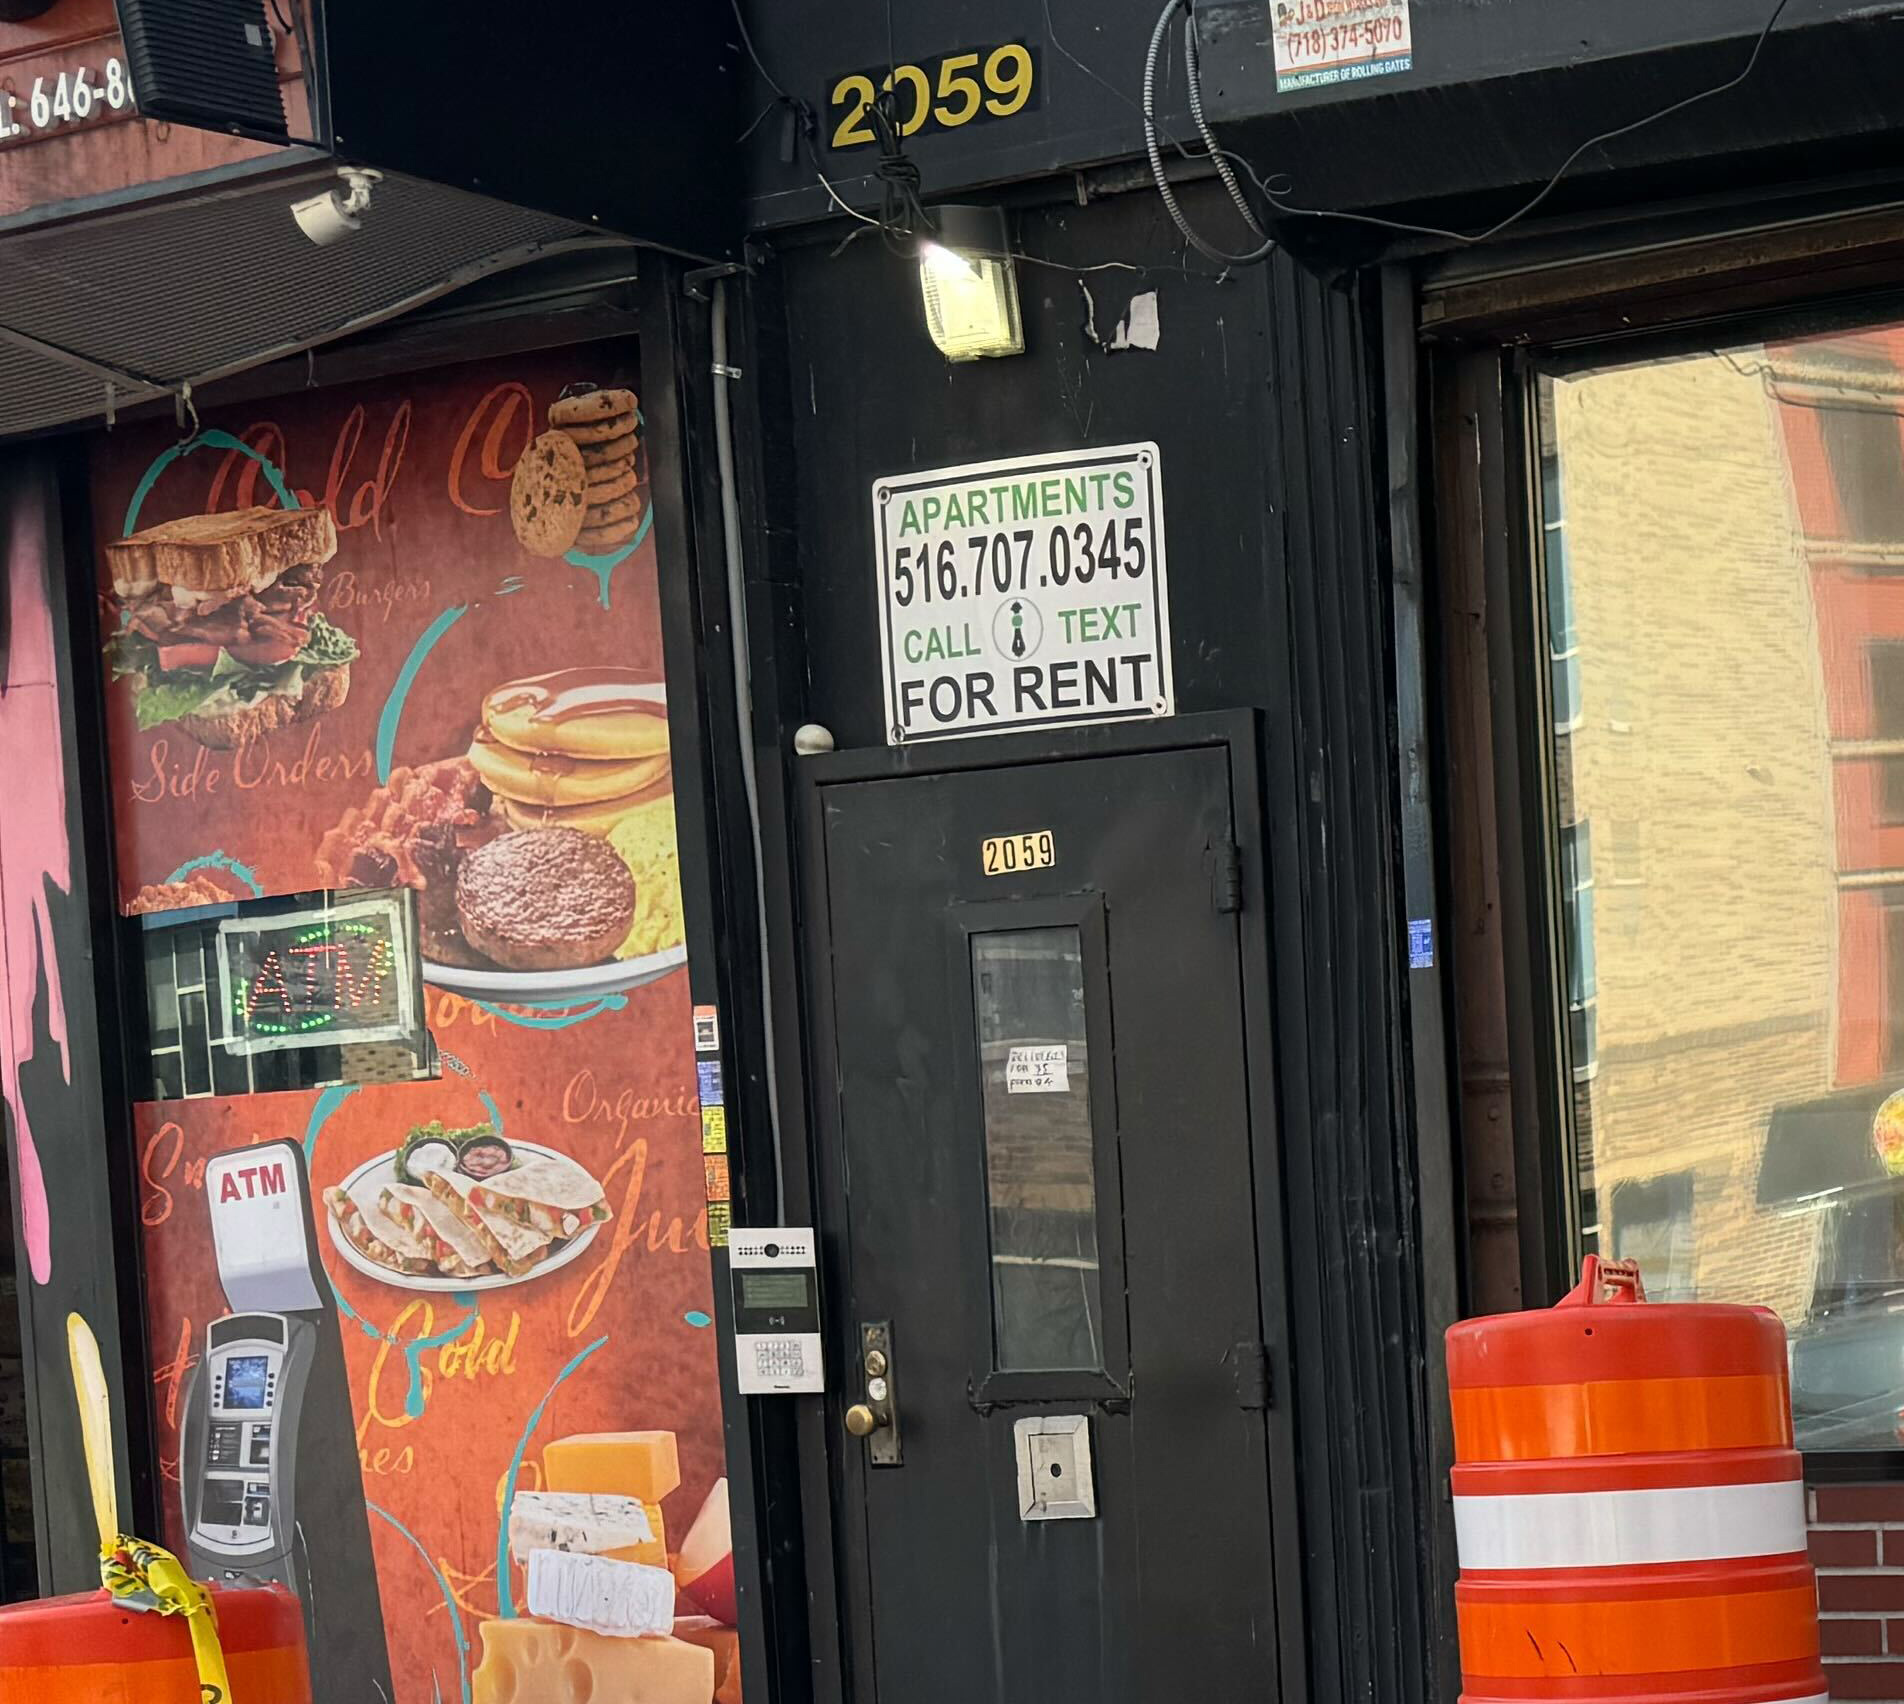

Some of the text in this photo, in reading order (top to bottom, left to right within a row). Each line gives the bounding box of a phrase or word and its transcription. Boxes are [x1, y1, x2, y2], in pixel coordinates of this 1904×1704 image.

[1279, 58, 1411, 89] MANUFACTURER OF ROLLING GATES
[1287, 16, 1403, 64] (718) 374-5070
[831, 44, 1034, 148] 2059
[899, 471, 1135, 538] APARTMENTS
[328, 572, 430, 612] Burgers
[895, 517, 1146, 607] 516.707.0345
[904, 602, 1142, 664] CALL TEXT
[900, 654, 1152, 727] FOR RENT
[130, 722, 373, 804] Side Orders
[984, 830, 1055, 875] 2059
[243, 936, 389, 1021] ATM
[563, 1069, 699, 1150] Organic
[219, 1163, 287, 1204] ATM
